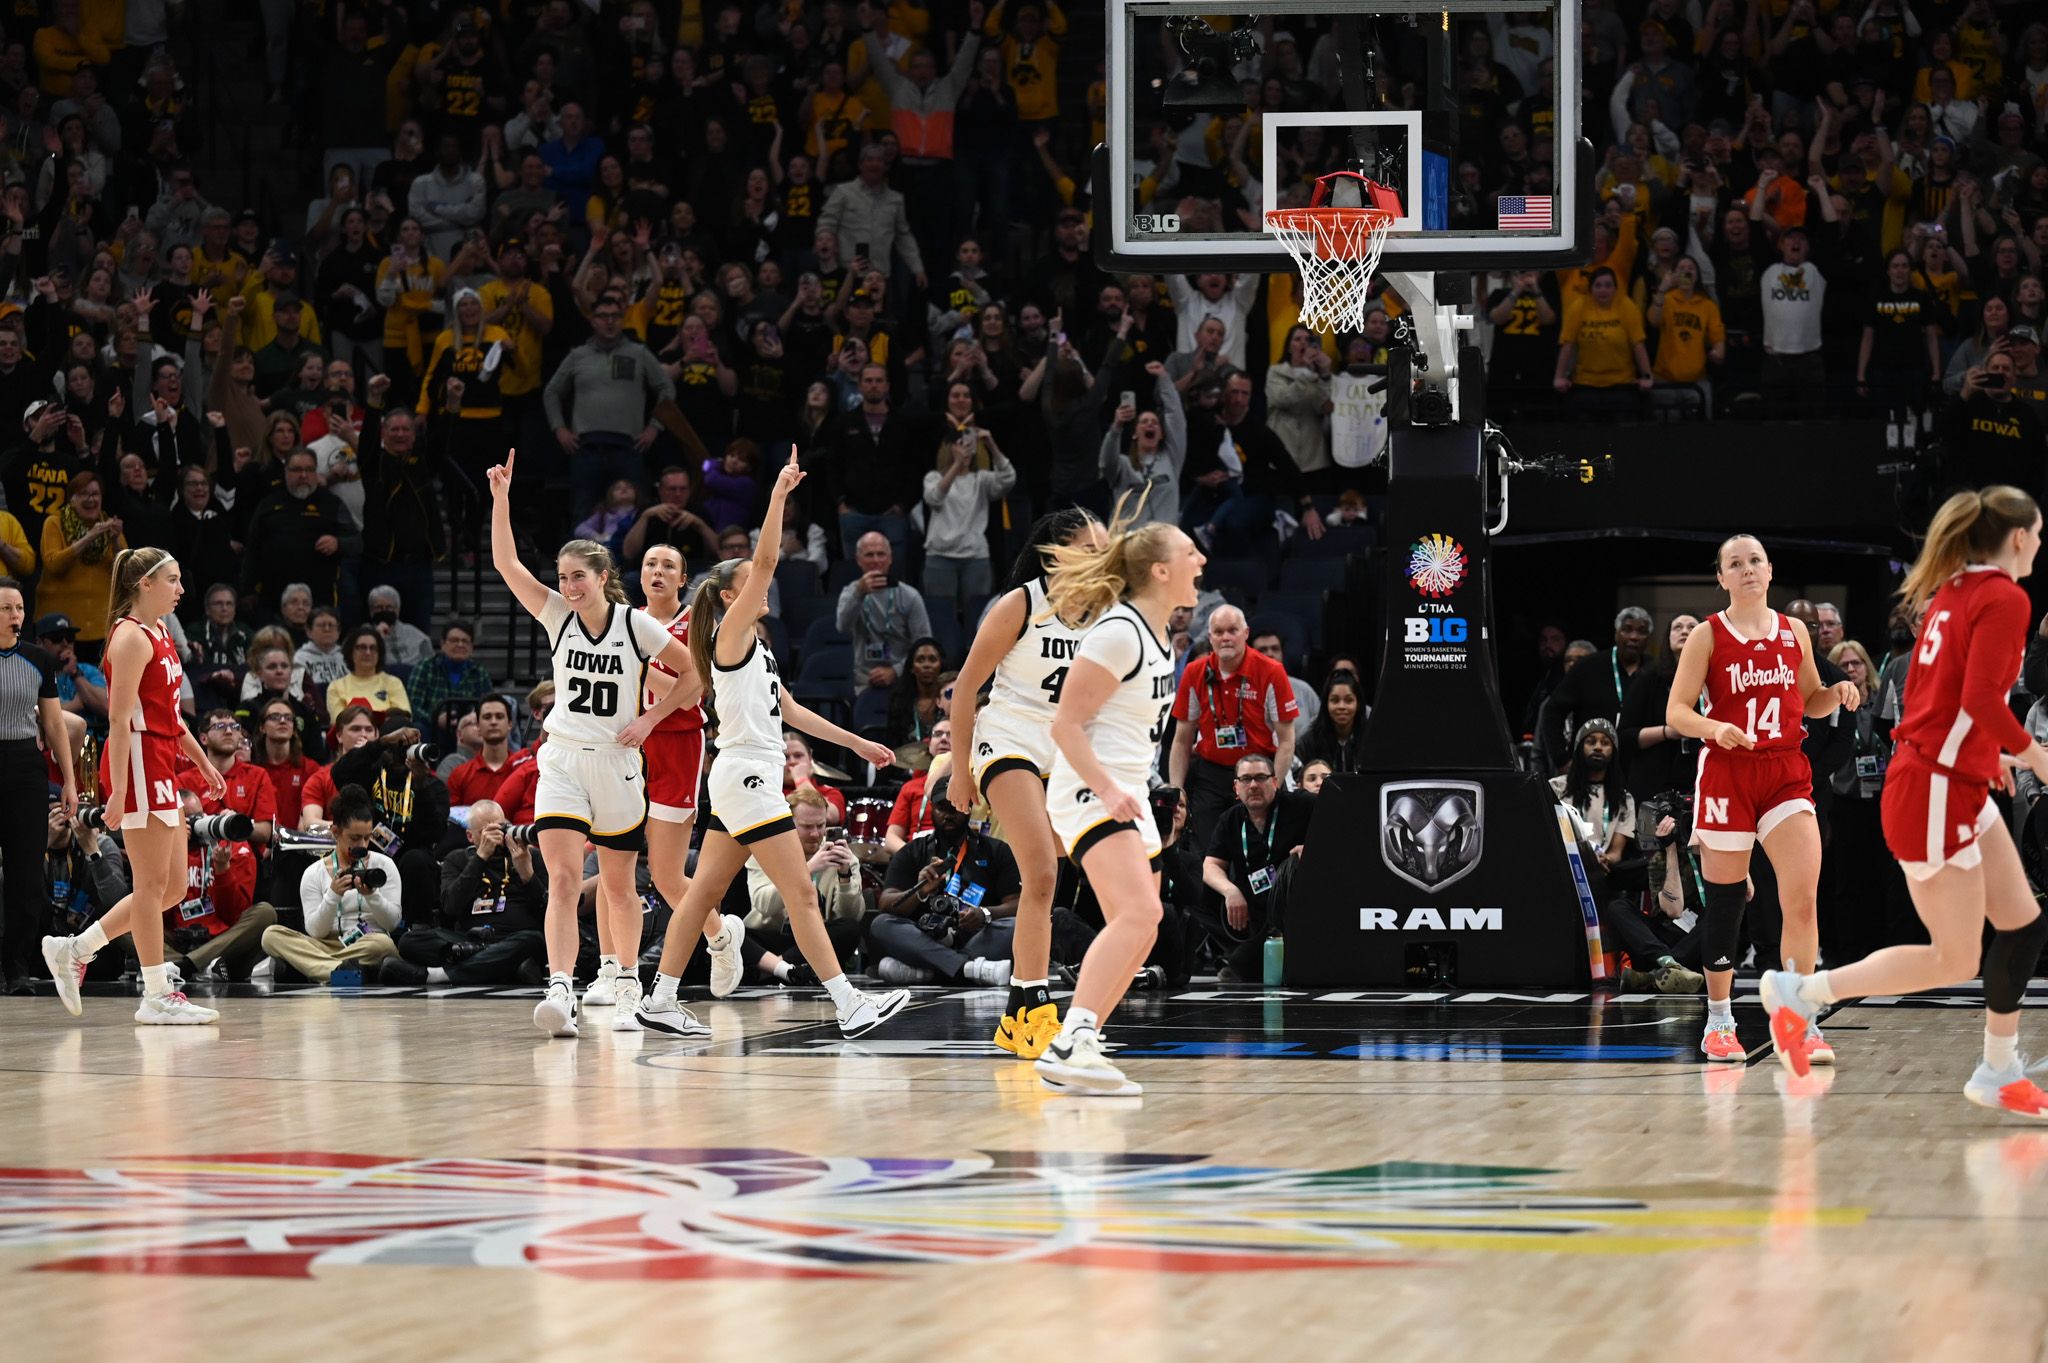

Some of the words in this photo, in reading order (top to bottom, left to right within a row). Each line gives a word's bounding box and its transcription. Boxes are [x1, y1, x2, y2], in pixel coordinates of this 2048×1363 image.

[447, 91, 480, 117] 22
[655, 299, 684, 326] 22
[1876, 302, 1920, 315] IOWA
[1504, 309, 1541, 336] 22
[1971, 417, 2021, 439] IOWA
[28, 481, 65, 515] 22
[1430, 603, 1454, 613] TIAA
[565, 649, 624, 675] IOWA
[1404, 654, 1467, 662] TOURNAMENT
[1725, 654, 1795, 695] Nebraska
[567, 676, 619, 718] 20
[1745, 697, 1782, 743] 14
[154, 778, 176, 805] N
[1705, 797, 1729, 825] N
[1359, 907, 1503, 931] RAM
